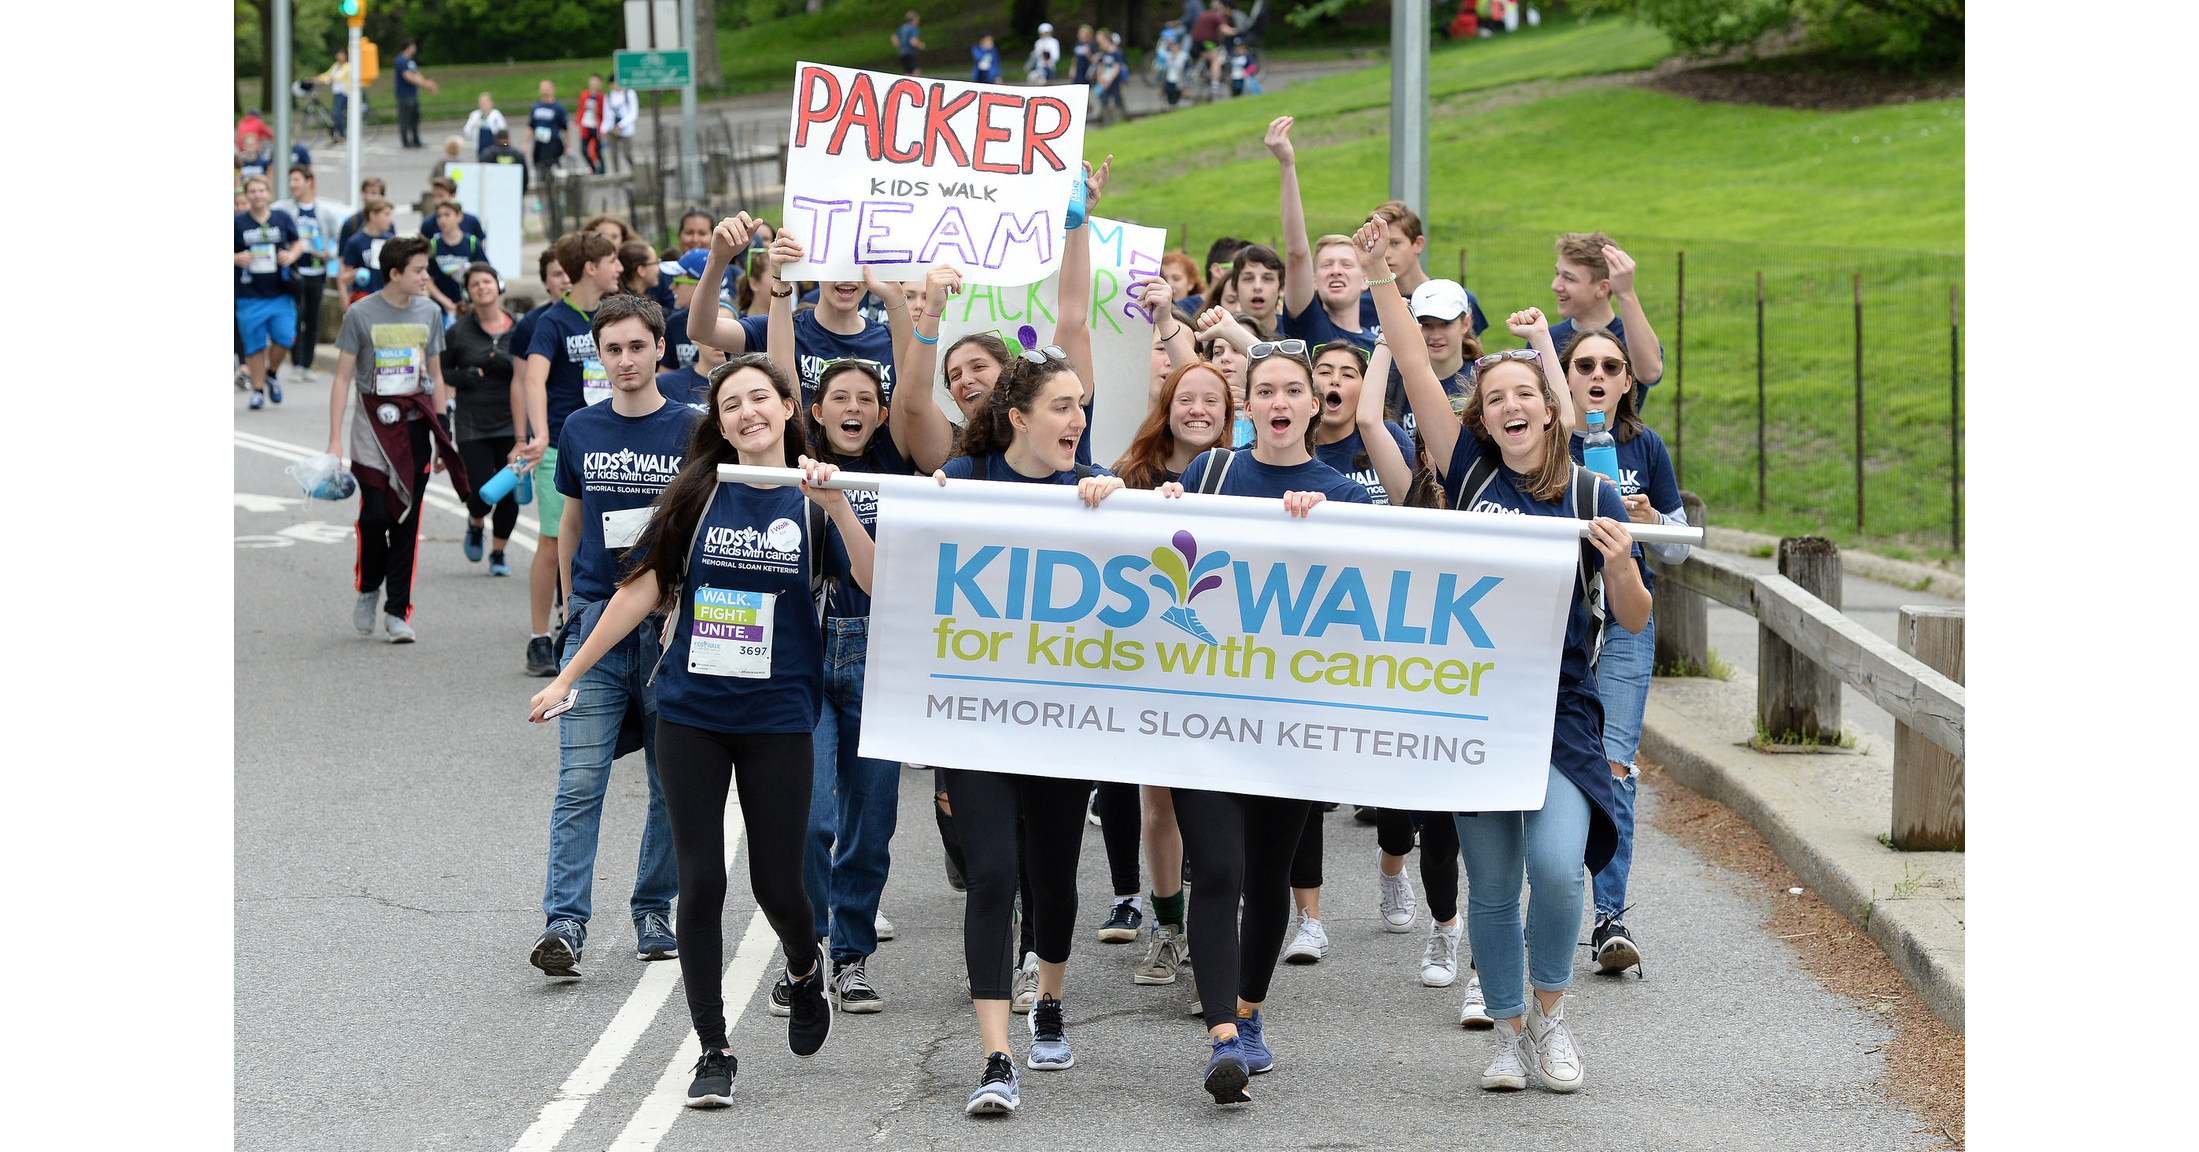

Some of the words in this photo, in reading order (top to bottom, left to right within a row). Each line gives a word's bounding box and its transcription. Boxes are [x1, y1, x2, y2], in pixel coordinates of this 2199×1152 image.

[795, 66, 1072, 174] PACKER
[870, 177, 929, 197] KIDS
[939, 182, 997, 203] WALK
[792, 196, 1052, 269] TEAM
[941, 268, 1123, 334] ACKR
[800, 354, 829, 374] KID
[584, 452, 620, 470] KIDS
[633, 453, 682, 474] WALK
[584, 469, 596, 480] for
[597, 468, 619, 480] kids
[620, 470, 641, 482] with
[643, 472, 677, 483] cance
[1619, 468, 1640, 486] LK
[617, 486, 641, 494] SLOAN
[705, 526, 744, 547] KIDS
[704, 543, 719, 553] for
[719, 544, 742, 556] kids
[742, 547, 764, 559] with
[765, 550, 800, 562] cancer
[702, 557, 737, 569] MEMORIAL
[738, 562, 762, 571] SLOAN
[763, 565, 799, 574] KETTERING
[702, 589, 751, 606] WALK.
[934, 542, 1152, 629] KIDS
[1232, 559, 1504, 649] WALK
[701, 606, 747, 622] FIGHT.
[699, 622, 749, 639] UNITE.
[740, 646, 767, 656] 3697
[933, 617, 1012, 662] for
[1027, 622, 1145, 671] kids
[1154, 635, 1276, 681] with
[1289, 651, 1494, 697] cancer
[926, 694, 1126, 734] MEMORIAL
[1138, 709, 1263, 746] SLOAN
[1277, 721, 1486, 766] KETTERING
